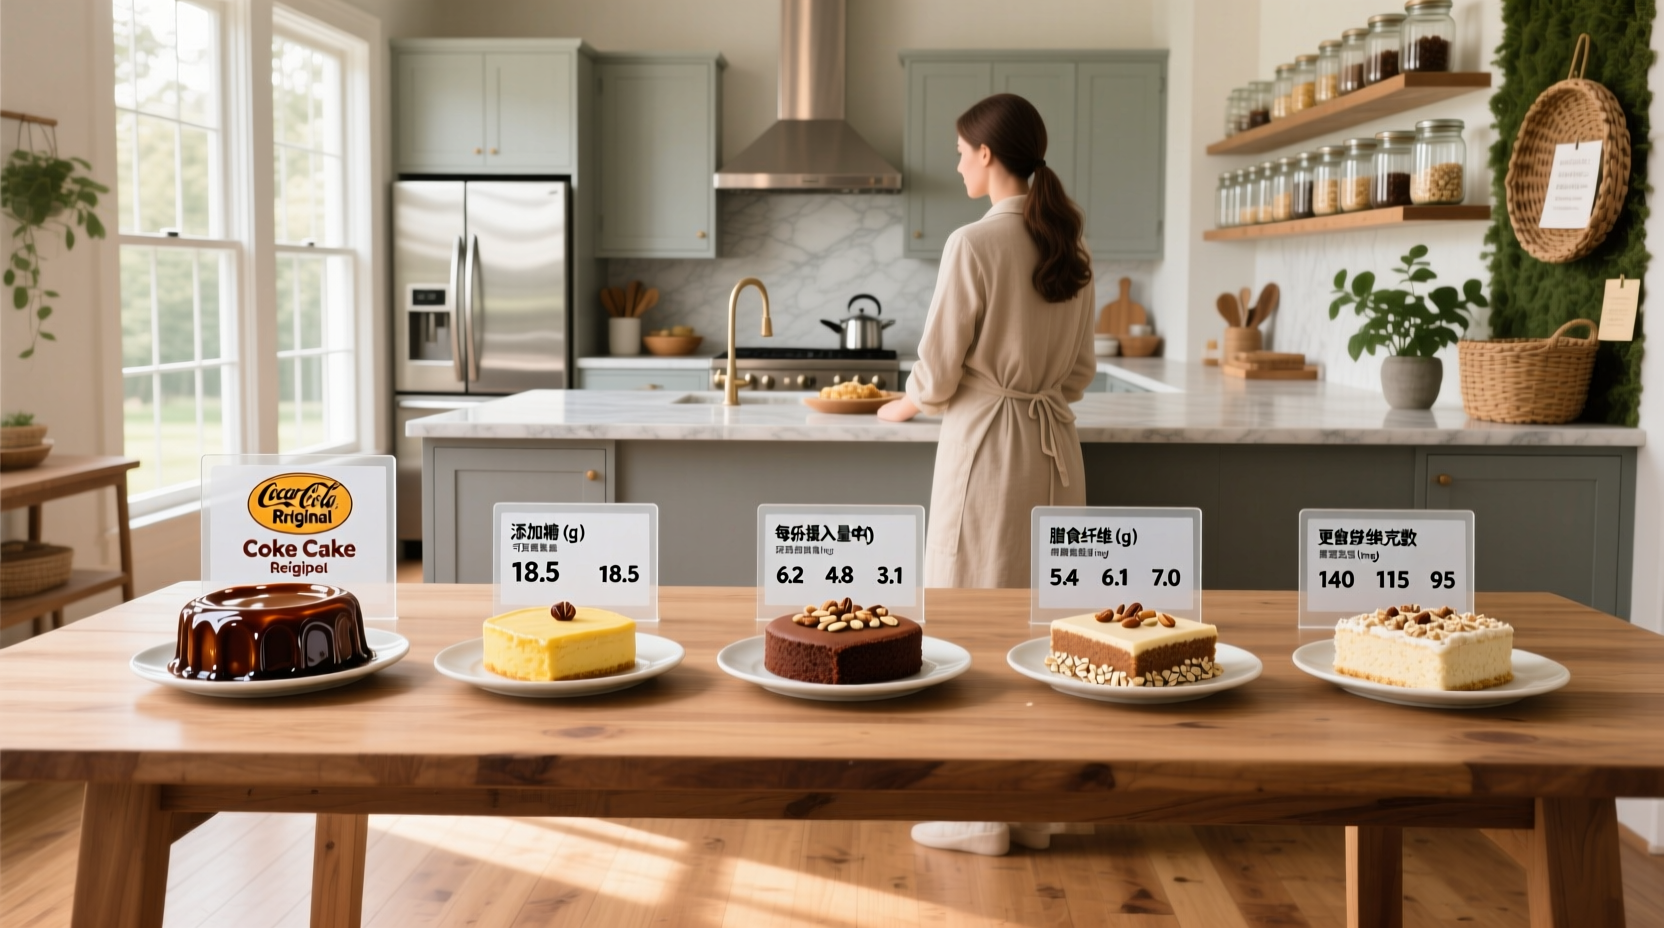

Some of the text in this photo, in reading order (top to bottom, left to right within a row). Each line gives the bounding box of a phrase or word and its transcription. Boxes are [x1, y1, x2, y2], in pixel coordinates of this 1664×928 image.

[563, 524, 585, 543] (g)
[1115, 528, 1138, 547] (g)
[243, 539, 356, 558] Coke Cake
[512, 561, 640, 583] 18.5 18.5
[776, 566, 902, 584] 6.2 4.8 3.1
[1050, 568, 1181, 587] 5.4 6.1 7.0
[1319, 570, 1455, 589] 140 115 95
